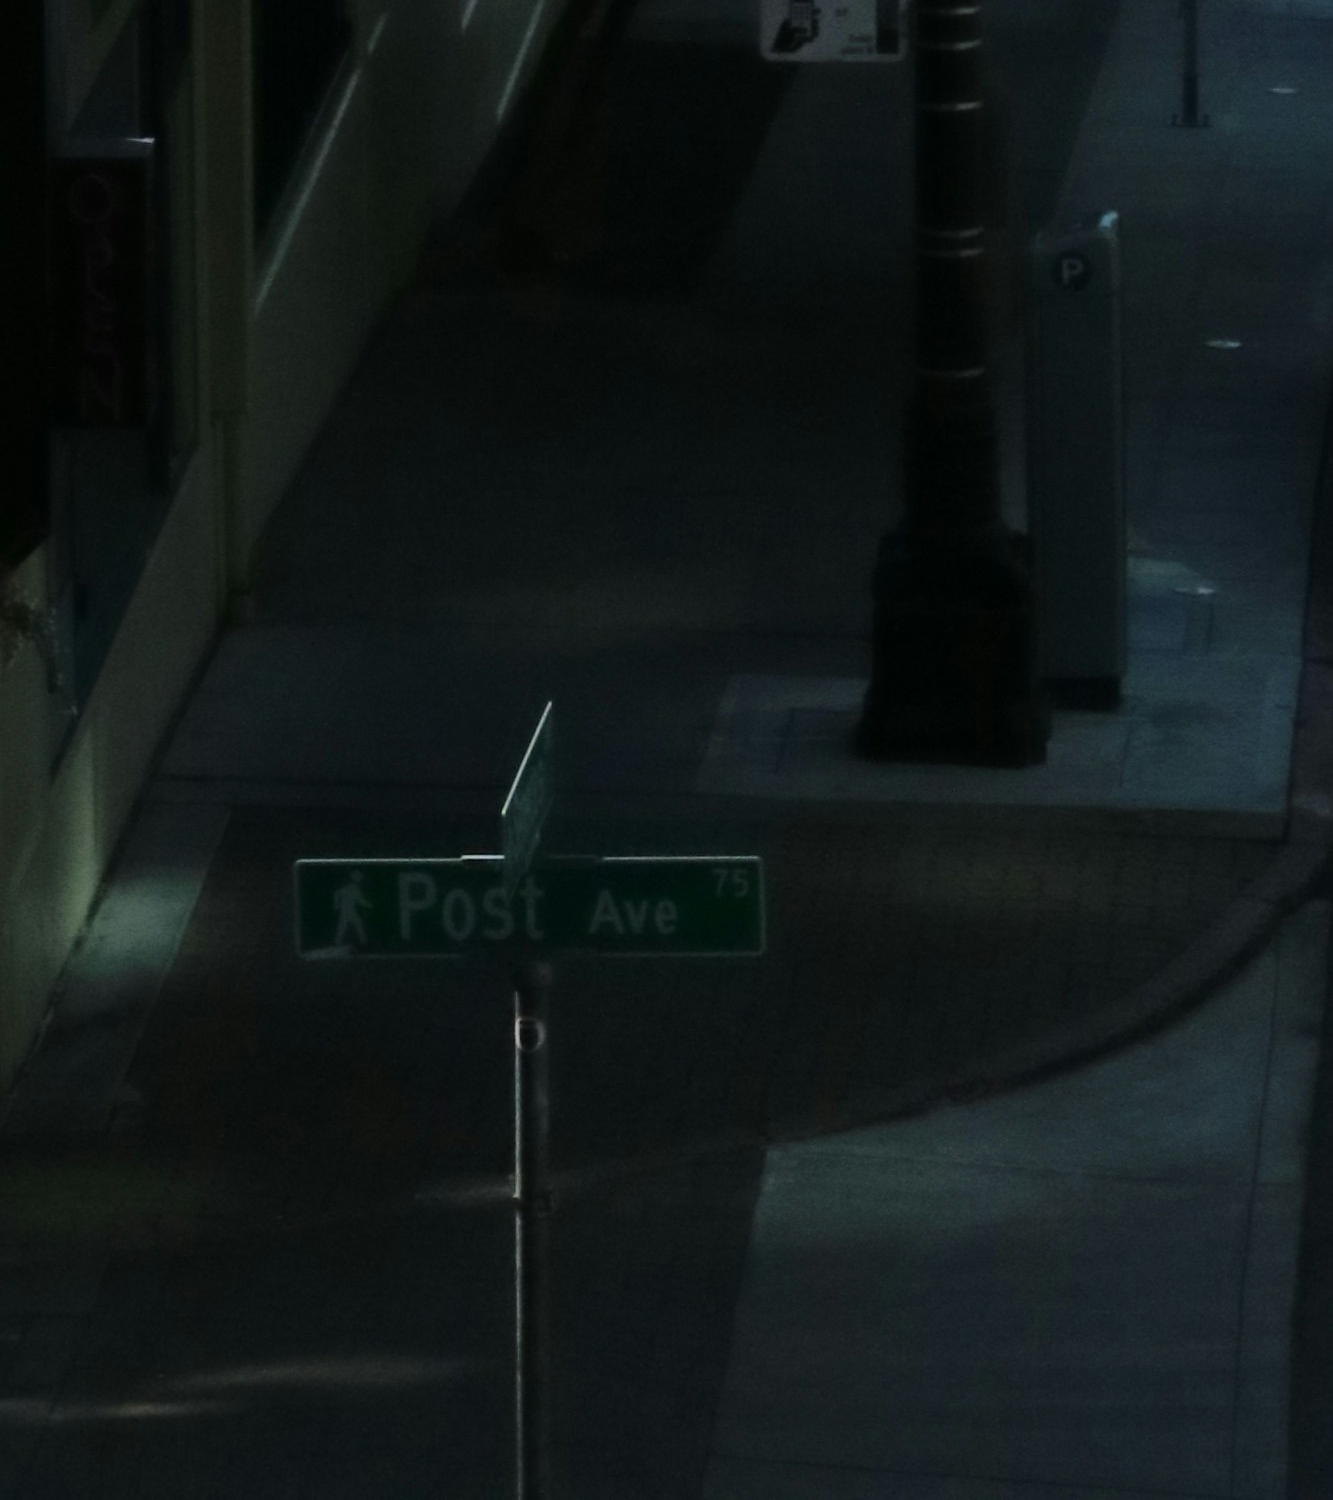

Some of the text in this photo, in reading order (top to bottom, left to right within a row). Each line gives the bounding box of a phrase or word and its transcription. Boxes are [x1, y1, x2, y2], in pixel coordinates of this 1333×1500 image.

[1061, 257, 1085, 285] P
[711, 867, 752, 900] 75
[396, 870, 680, 942] Post Ave
